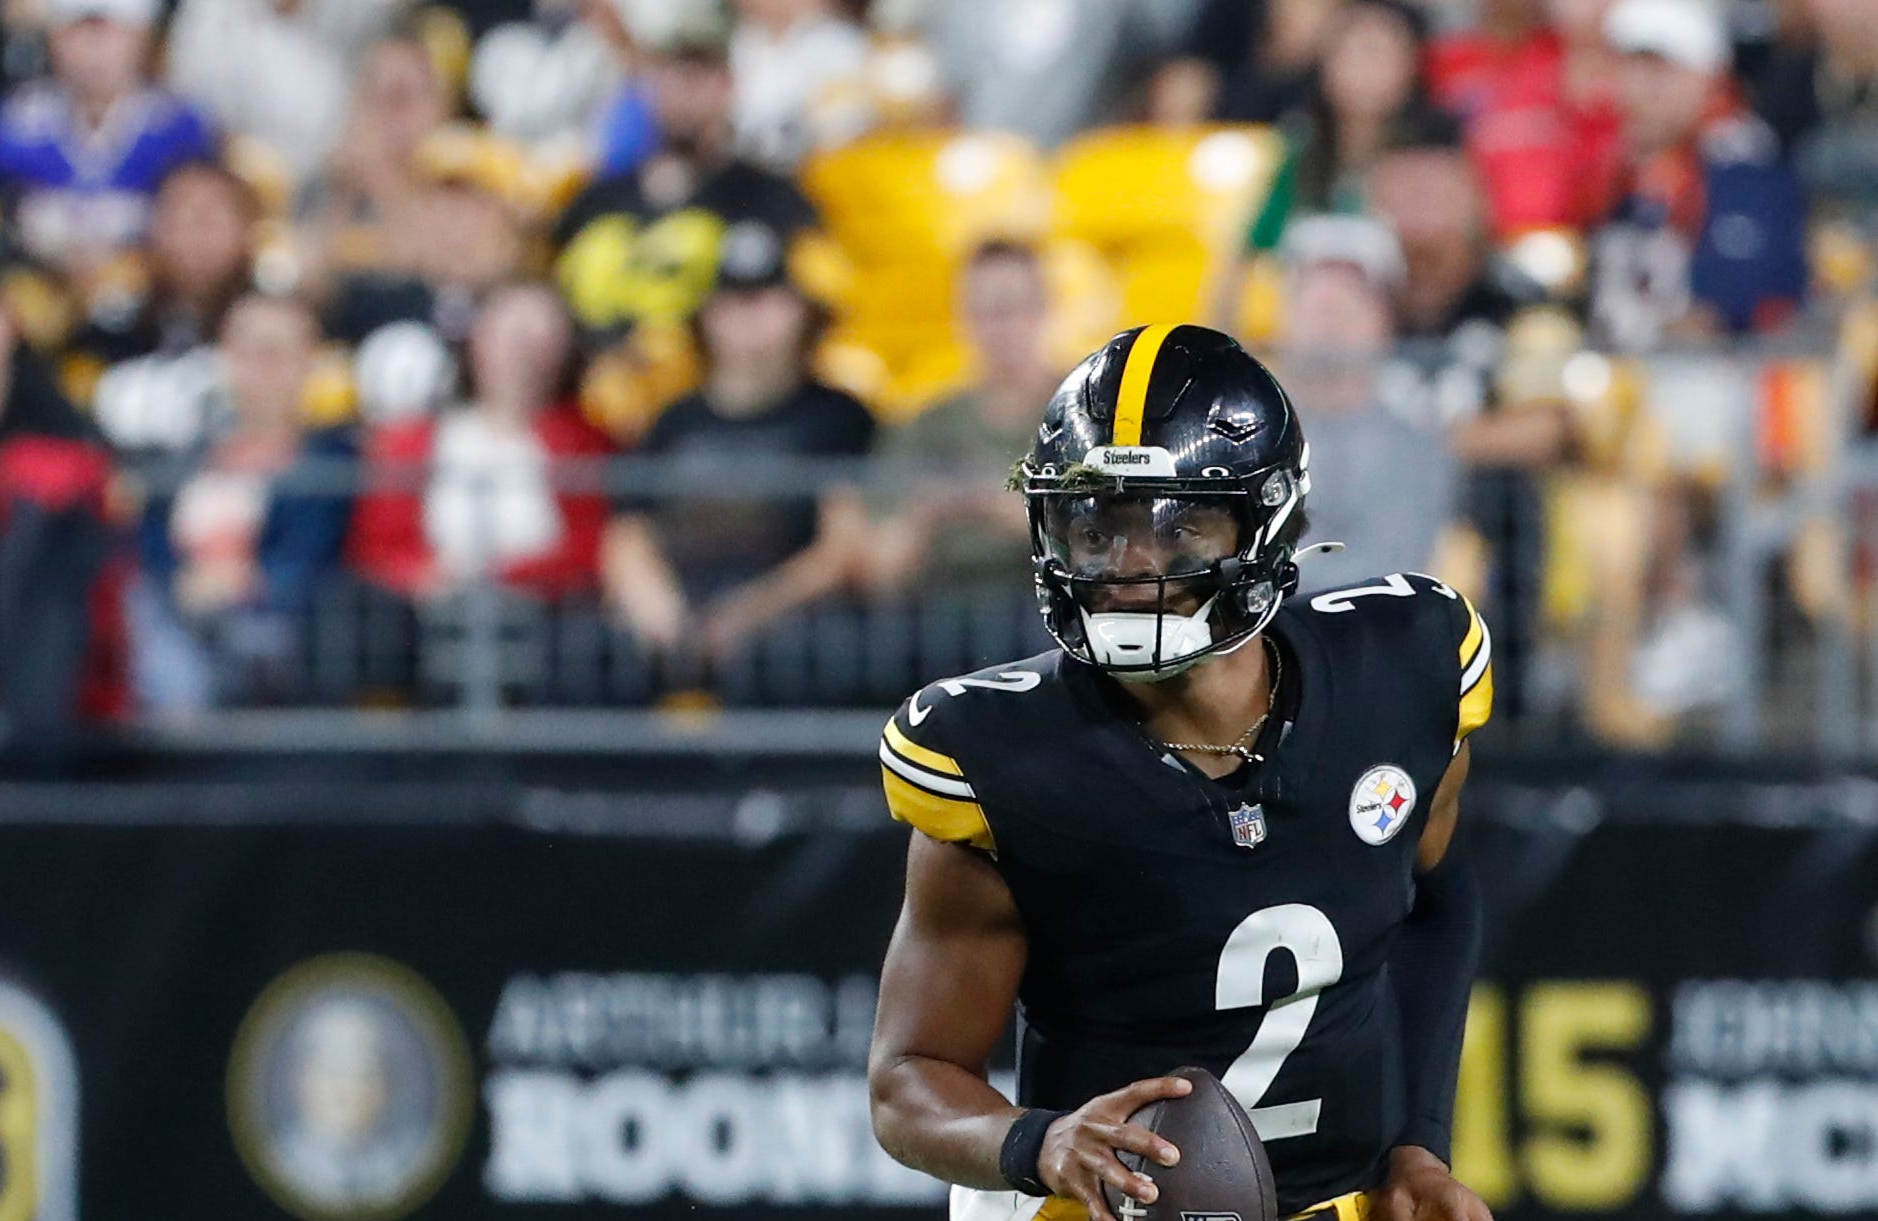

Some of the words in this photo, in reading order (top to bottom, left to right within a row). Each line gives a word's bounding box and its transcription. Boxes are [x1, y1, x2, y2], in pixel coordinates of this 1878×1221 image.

[1103, 451, 1150, 464] Steelers
[937, 671, 1042, 697] 2
[1215, 903, 1343, 1142] 2
